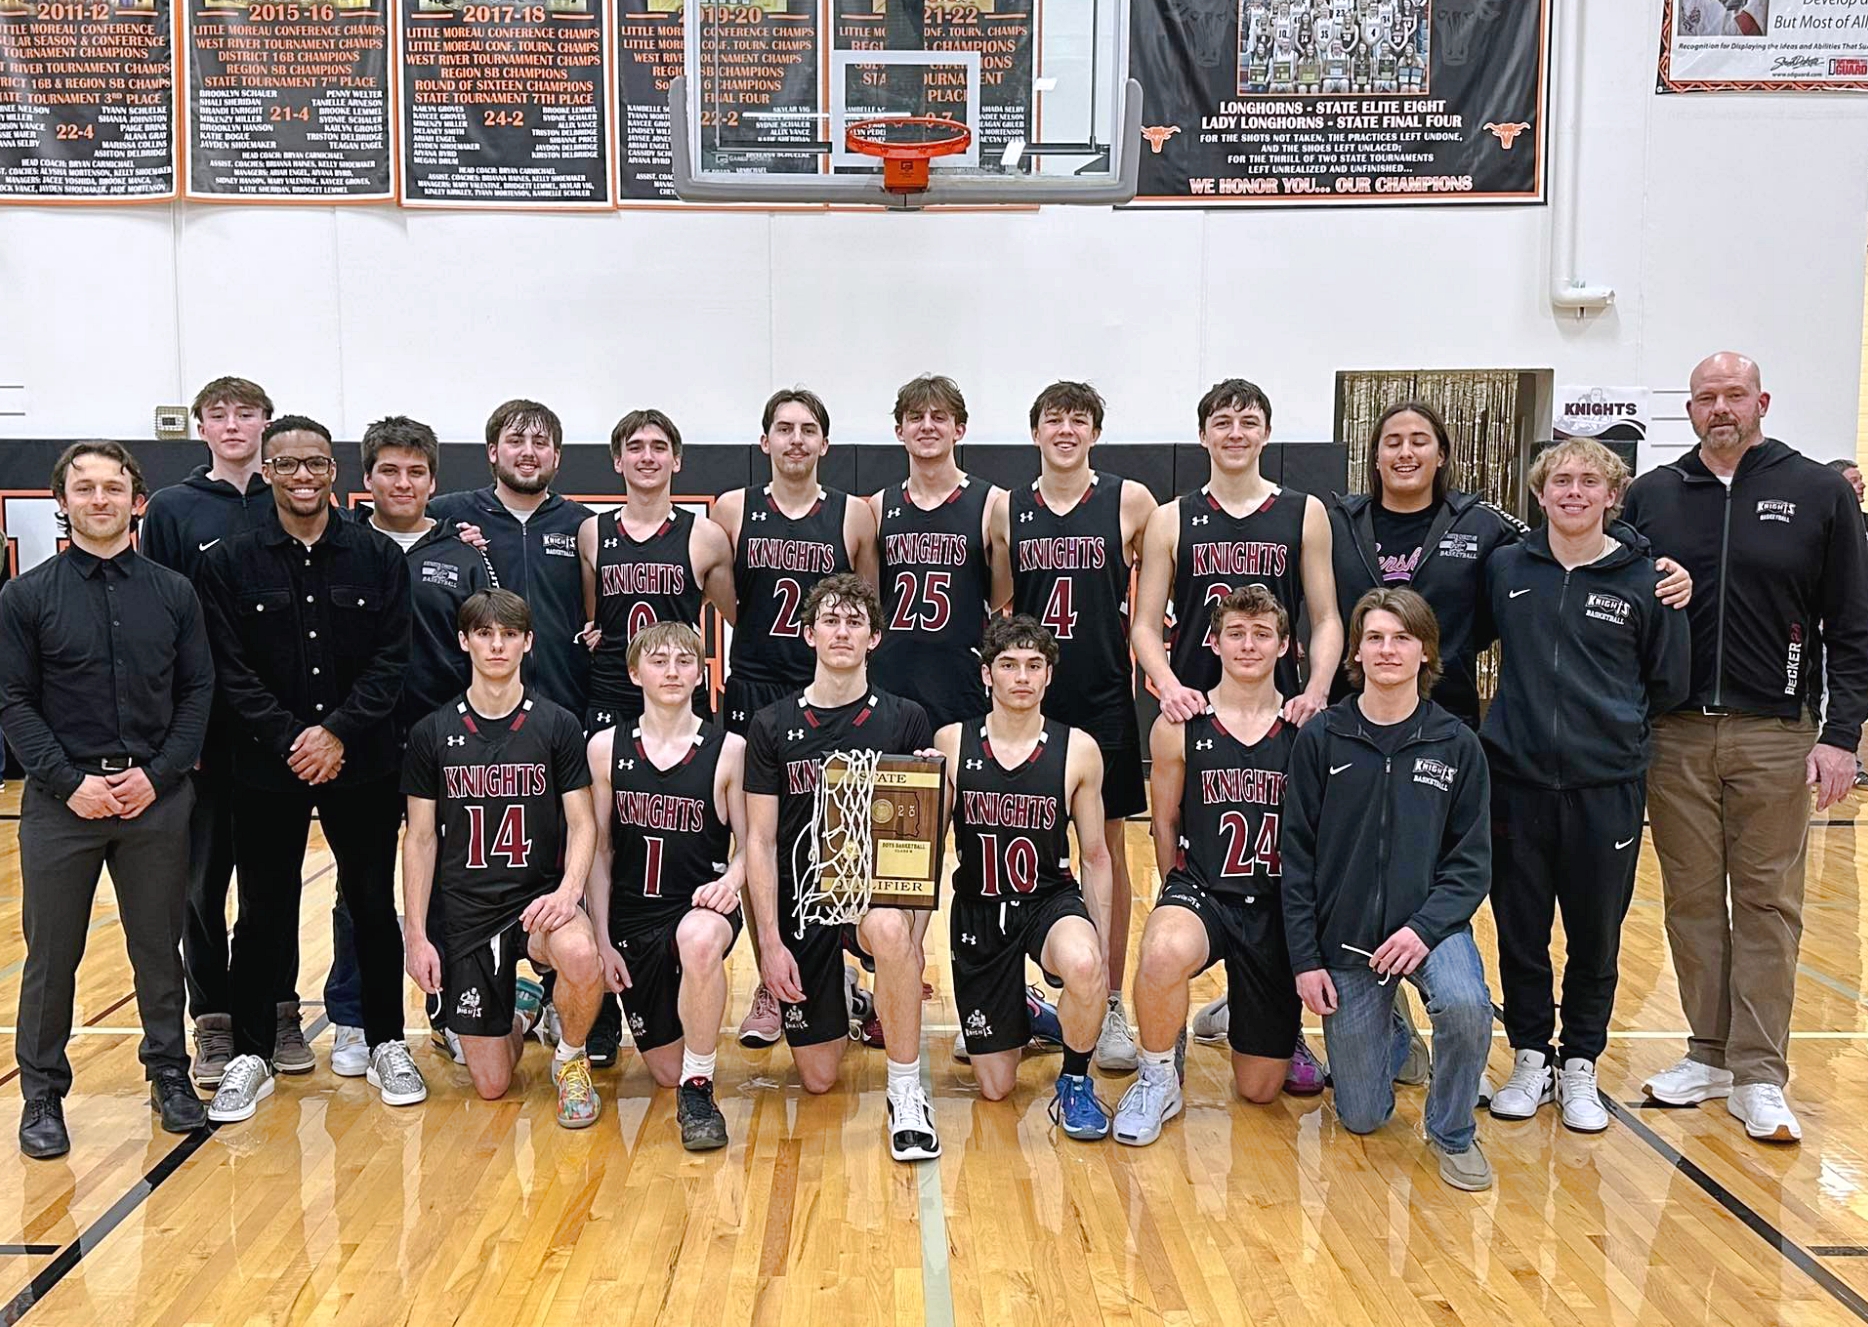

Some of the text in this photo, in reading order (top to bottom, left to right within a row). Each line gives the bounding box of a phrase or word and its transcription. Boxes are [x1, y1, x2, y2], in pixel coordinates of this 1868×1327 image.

[37, 3, 109, 20] 2011-12
[463, 6, 545, 23] 2017-18
[1775, 15, 1795, 29] But
[1801, 15, 1833, 29] Most
[1836, 15, 1849, 29] of
[30, 24, 154, 35] MOREAU CONFERENCE
[193, 25, 385, 36] LITTLE MOREAU CONFERENCE CHAMPS
[407, 28, 600, 39] LITTLE MOREAU CONFERENCE CHAMPS
[622, 26, 814, 37] LITTLE CHAMPS
[840, 27, 875, 37] LITTLE
[949, 27, 1027, 37] TOURN. CHAMPS
[34, 36, 165, 46] SEASON CONFERENCE
[197, 39, 383, 50] WEST RIVER TOURNAMENT CHAMPS
[409, 41, 598, 53] LITTLE MOREAU CONF. TOURN. CHAMPS
[624, 40, 812, 50] LITTLE TOURN. CHAMPS
[933, 40, 1016, 51] CHAMPIONS
[1731, 43, 1766, 51] Displaying
[4, 48, 148, 58] TOURNAMENT CHAMPIONS
[218, 51, 359, 62] DISTRICT CHAMPIONS
[634, 53, 802, 63] WEST CHAMPS
[406, 55, 435, 65] WEST
[439, 55, 469, 65] RIVER
[557, 55, 600, 66] CHAMPS
[10, 63, 170, 74] RIVER TOURNAMENT CHAMPS
[227, 65, 352, 75] REGION CHAMPIONS
[441, 68, 567, 79] REGION CHAMPIONS
[1836, 65, 1867, 75] GUARD
[31, 78, 170, 89] 16B REGION CHAMPS
[205, 77, 377, 87] STATE TOURNAMENT PLACE
[415, 81, 593, 92] ROUND OF SIXTEEN CHAMPIONS
[27, 93, 161, 104] TOURNAMENT PLACE
[415, 93, 593, 104] STATE TOURNAMENT 7TH PLACE
[739, 93, 769, 104] FOUR
[1220, 100, 1446, 114] LONGHORNS STATE ELITE EIGHT
[270, 107, 310, 121] 21-4
[484, 111, 524, 126] 24-2
[1202, 116, 1462, 129] LADY LONGHORNS STATE FINAL FOUR
[56, 124, 94, 140] 22-4
[1200, 134, 1218, 143] FOR
[1221, 134, 1238, 142] THE
[1241, 134, 1270, 143] SHOTS
[1273, 134, 1290, 142] NOT
[1293, 134, 1324, 143] TAKEN,
[1348, 133, 1397, 141] PRACTICES
[1400, 133, 1421, 141] LEFT
[1424, 133, 1463, 142] UNDONE,
[1335, 144, 1355, 152] LEFT
[1228, 154, 1434, 163] FOR THE THRILL OF TWO STATE TOURNAMENTS
[1248, 165, 1347, 174] LEFT UNREALIZED AND
[1189, 176, 1473, 194] WE HONOR YOU... OUR CHAMPIONS
[1564, 403, 1637, 416] KNIGHTS
[1756, 500, 1796, 515] KNIGHTS
[543, 534, 576, 550] KNIGHTS
[748, 538, 835, 574] KNIGHTS
[886, 533, 967, 566] KNIGHTS
[1019, 537, 1105, 572] KNIGHTS
[1192, 541, 1287, 577] KNIGHTS
[601, 563, 685, 596] KNIGHTS
[769, 578, 802, 638] 2
[889, 571, 951, 632] 25
[1041, 576, 1078, 639] 4
[1587, 594, 1631, 616] KNIGHTS
[1586, 610, 1624, 625] BASKETBALL
[1412, 758, 1458, 784] KNIGHTS
[444, 763, 546, 798] KNIGHTS
[1413, 775, 1448, 791] BASKETBALL
[616, 791, 704, 832] KNIGHTS
[963, 790, 1057, 830] KNIGHTS
[464, 804, 533, 868] 14
[1218, 811, 1282, 878] 24
[643, 836, 663, 897] 1
[977, 833, 1038, 896] 10
